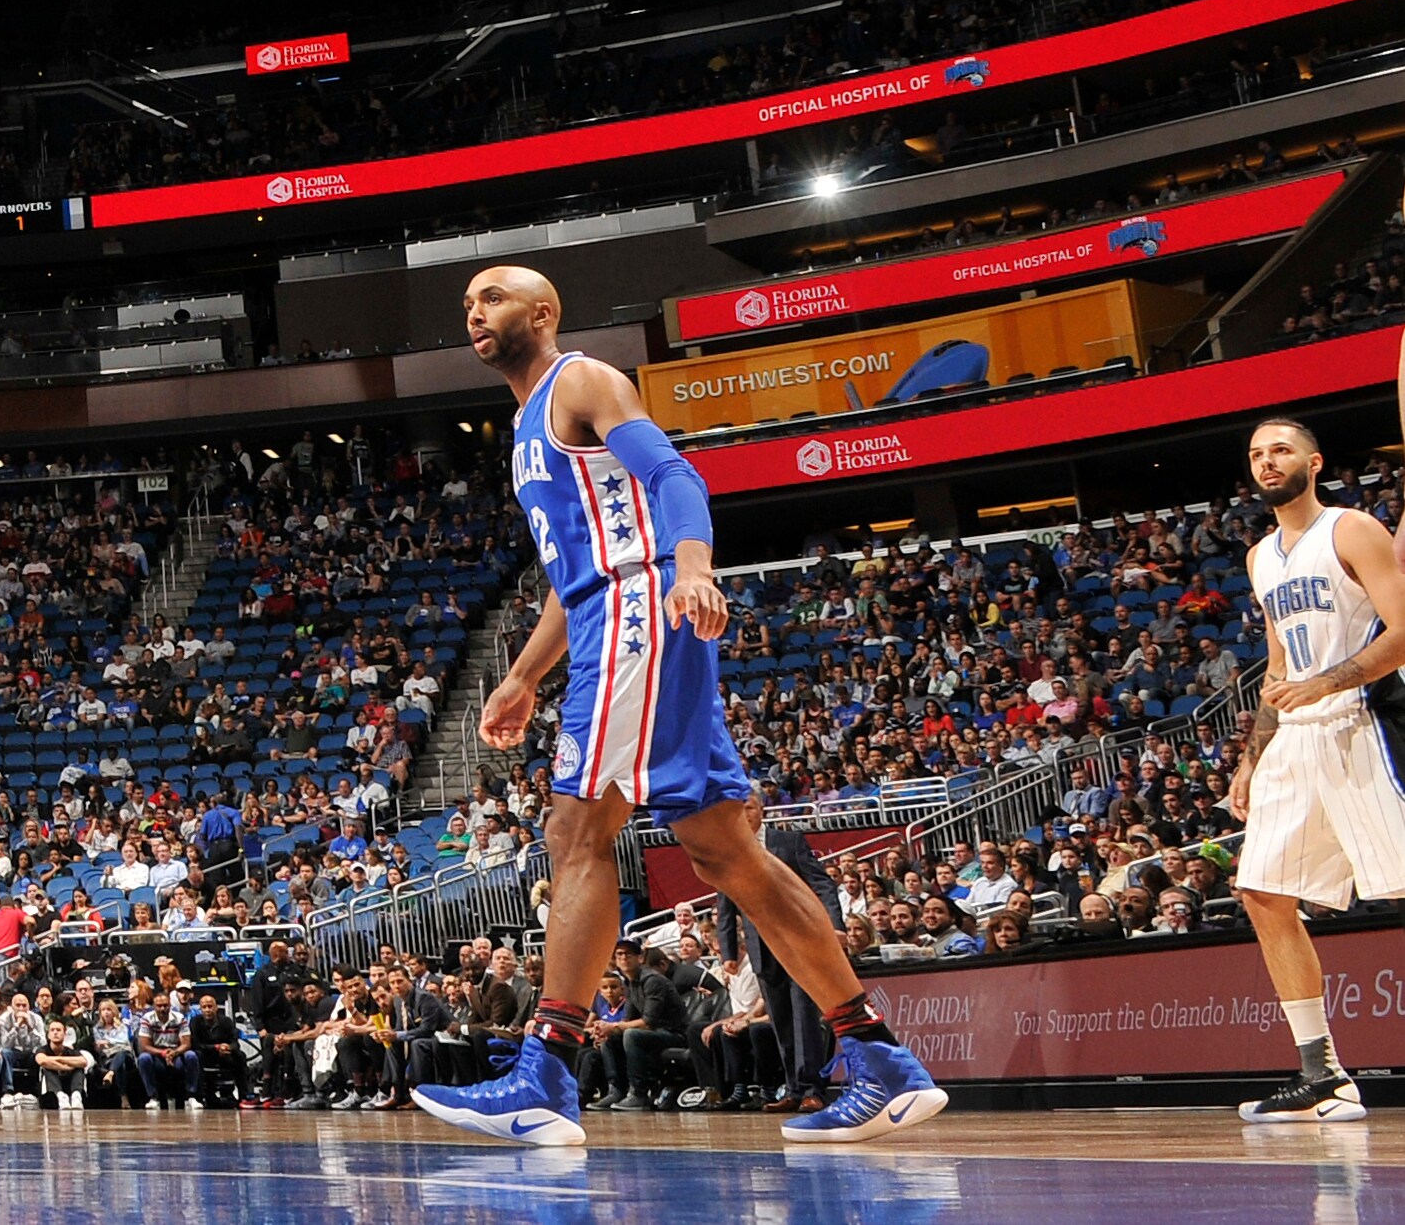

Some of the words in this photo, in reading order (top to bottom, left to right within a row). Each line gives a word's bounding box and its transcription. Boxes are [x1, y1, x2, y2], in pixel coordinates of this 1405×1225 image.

[283, 42, 330, 56] FLORIDA
[284, 52, 337, 66] HOSPITAL
[759, 97, 827, 121] OFFICIAL
[831, 80, 906, 108] HOSPITAL
[909, 76, 930, 91] OF
[294, 174, 345, 188] FLORIDA
[296, 184, 353, 199] HOSPITAL
[16, 216, 24, 231] 1
[953, 262, 1011, 281] OFFICIAL
[1014, 250, 1074, 270] HOSPITAL
[1076, 244, 1093, 258] OF
[772, 284, 839, 305] FLORIDA
[774, 297, 850, 320] HOSPITAL
[673, 352, 890, 402] SOUTHWEST.COM
[834, 435, 901, 455] FLORIDA
[836, 448, 912, 471] HOSPITAL
[140, 476, 167, 489] 102
[1263, 576, 1335, 625] MAGIC
[897, 994, 971, 1025] FLORIDA
[1013, 1011, 1041, 1036] You
[1046, 1008, 1112, 1042] Support
[1118, 1002, 1145, 1030] the
[1150, 999, 1224, 1029] Orlando
